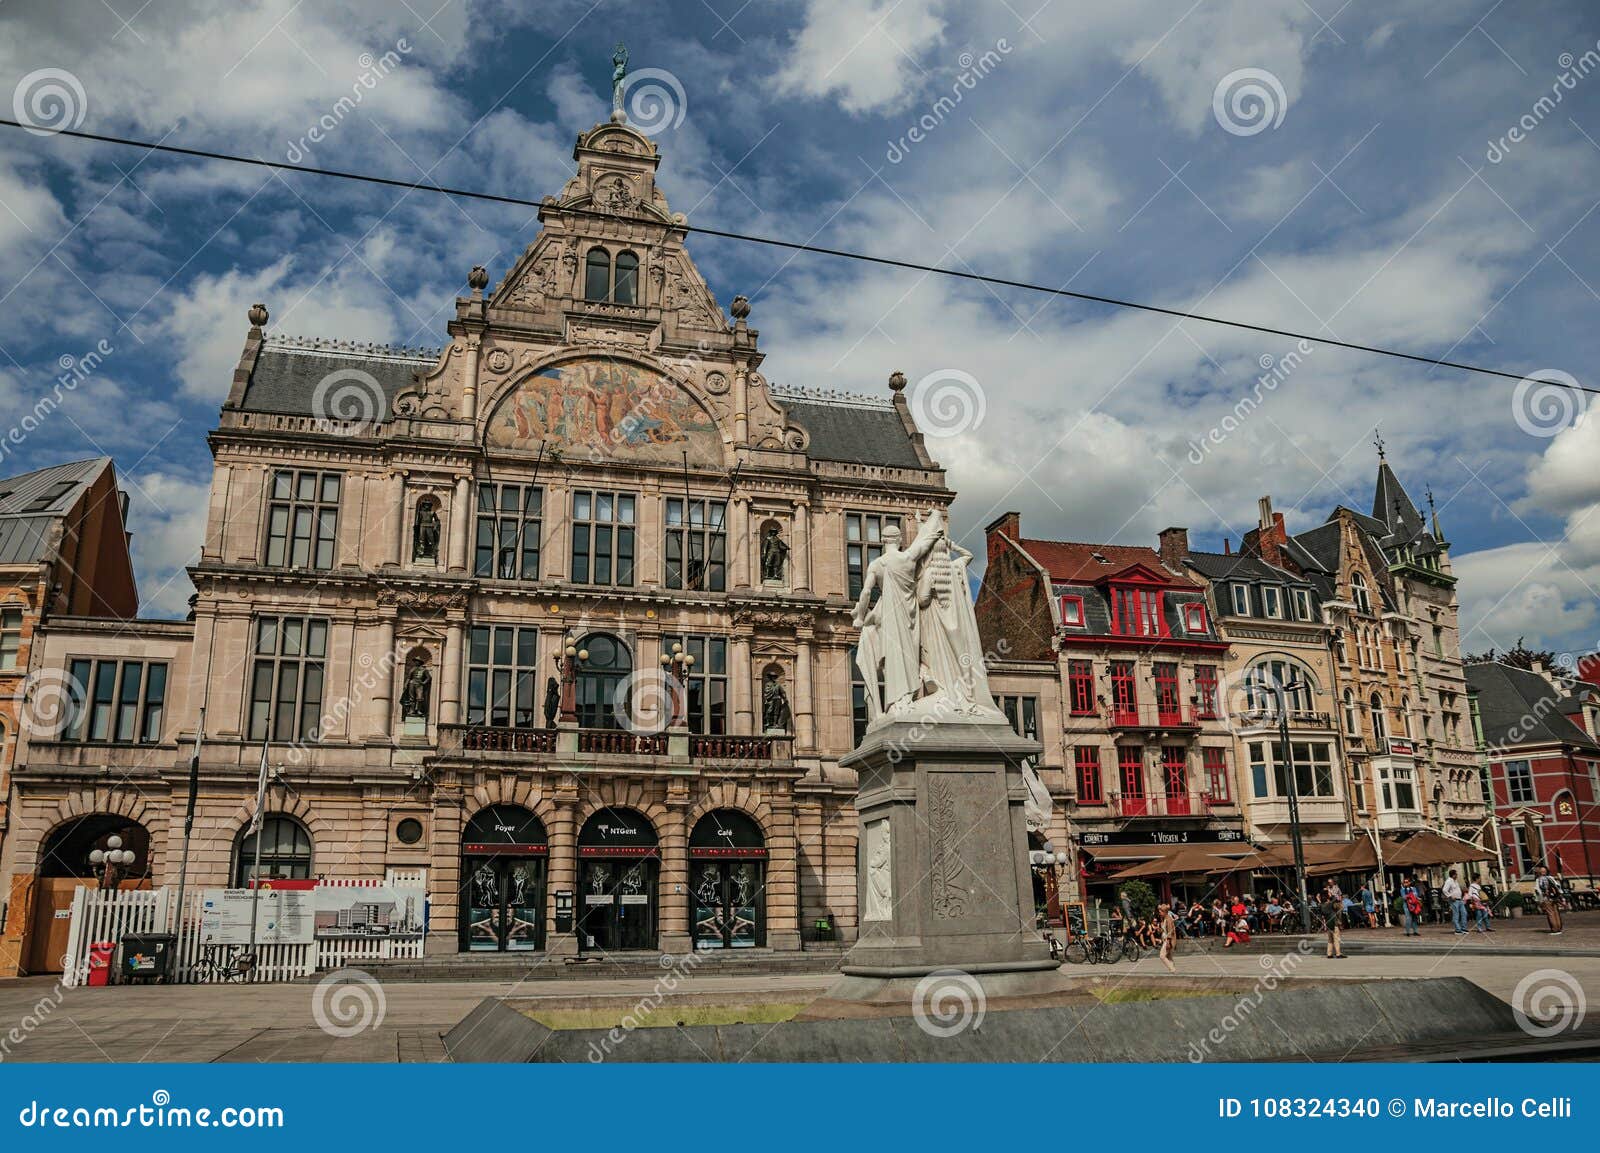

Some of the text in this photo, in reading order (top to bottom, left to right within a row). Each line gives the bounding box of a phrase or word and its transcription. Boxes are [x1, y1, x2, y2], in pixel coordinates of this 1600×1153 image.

[494, 824, 516, 833] Foyer
[610, 827, 637, 835] NTGent
[717, 828, 733, 836] Café
